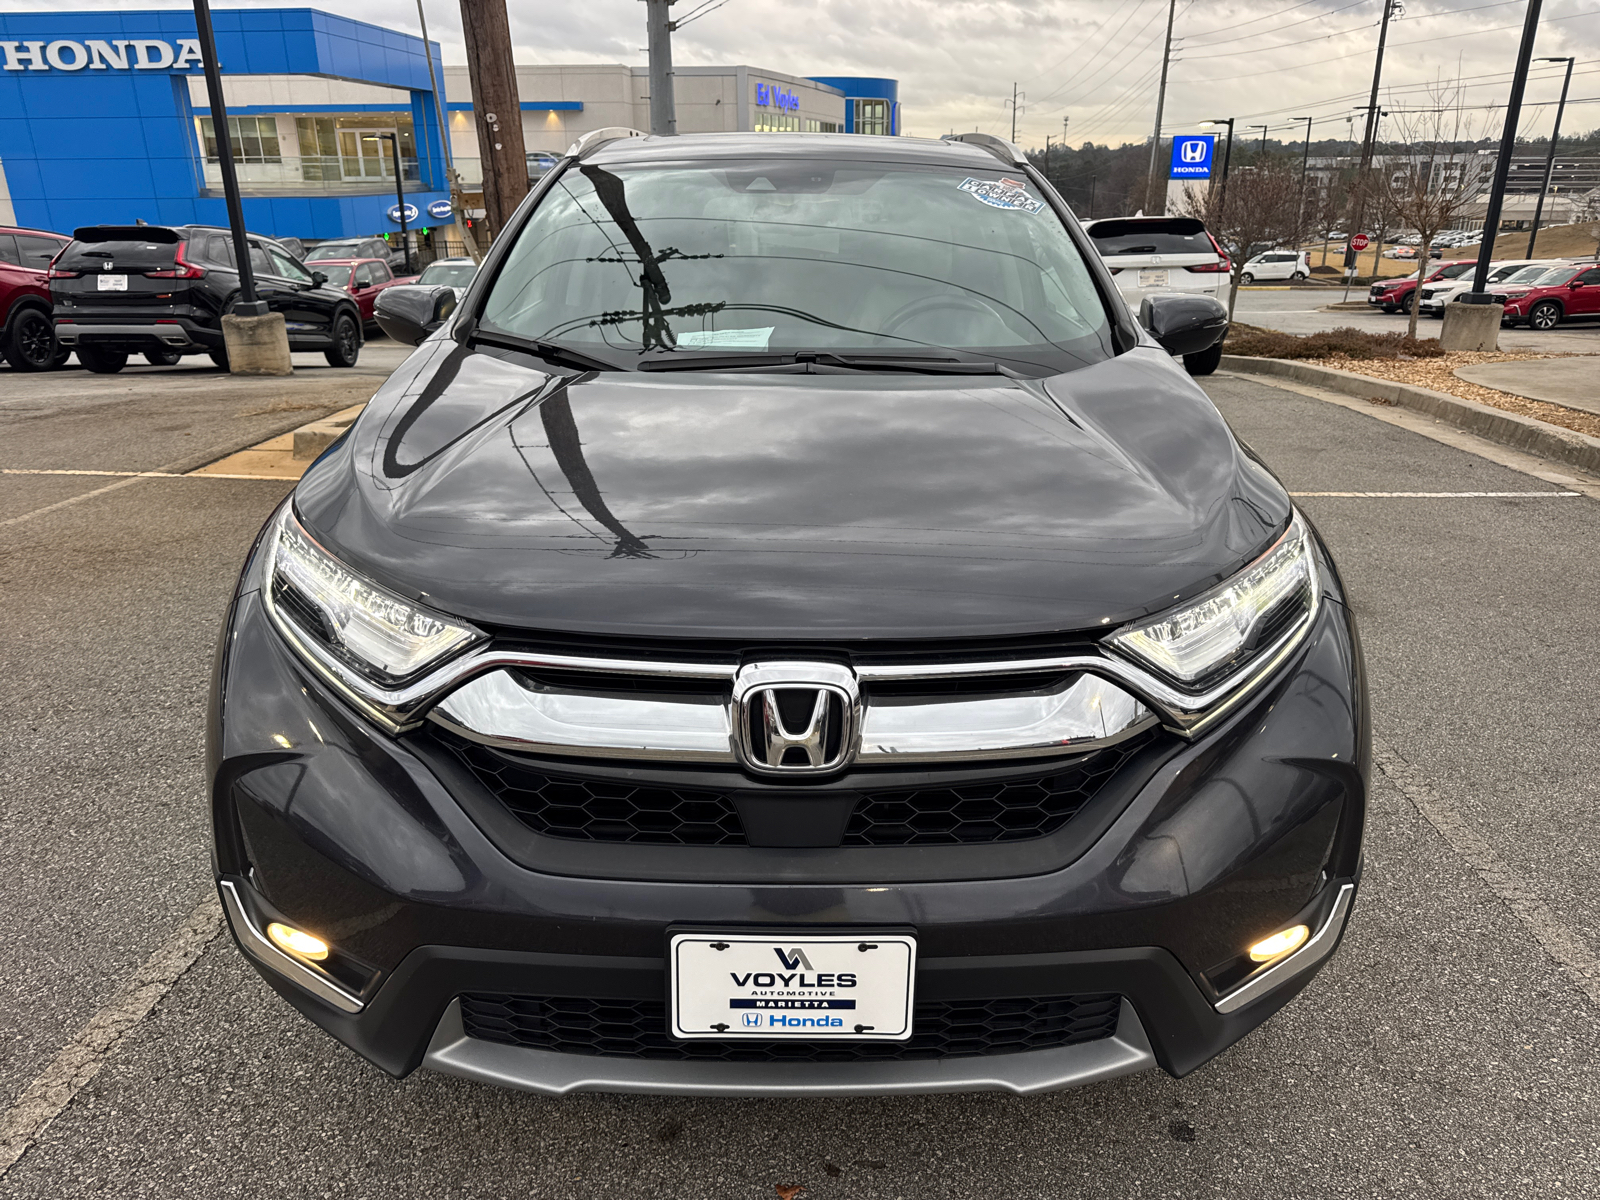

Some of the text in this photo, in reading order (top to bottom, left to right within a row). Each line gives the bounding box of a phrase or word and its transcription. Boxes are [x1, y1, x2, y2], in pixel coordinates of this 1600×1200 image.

[0, 39, 222, 71] HONDA
[757, 83, 799, 114] Ed Voyles
[1172, 166, 1210, 174] HONDA
[1352, 238, 1369, 247] STOP
[730, 972, 857, 988] VOYLES
[756, 1000, 830, 1008] MARIETTA
[769, 1014, 844, 1028] Honda
